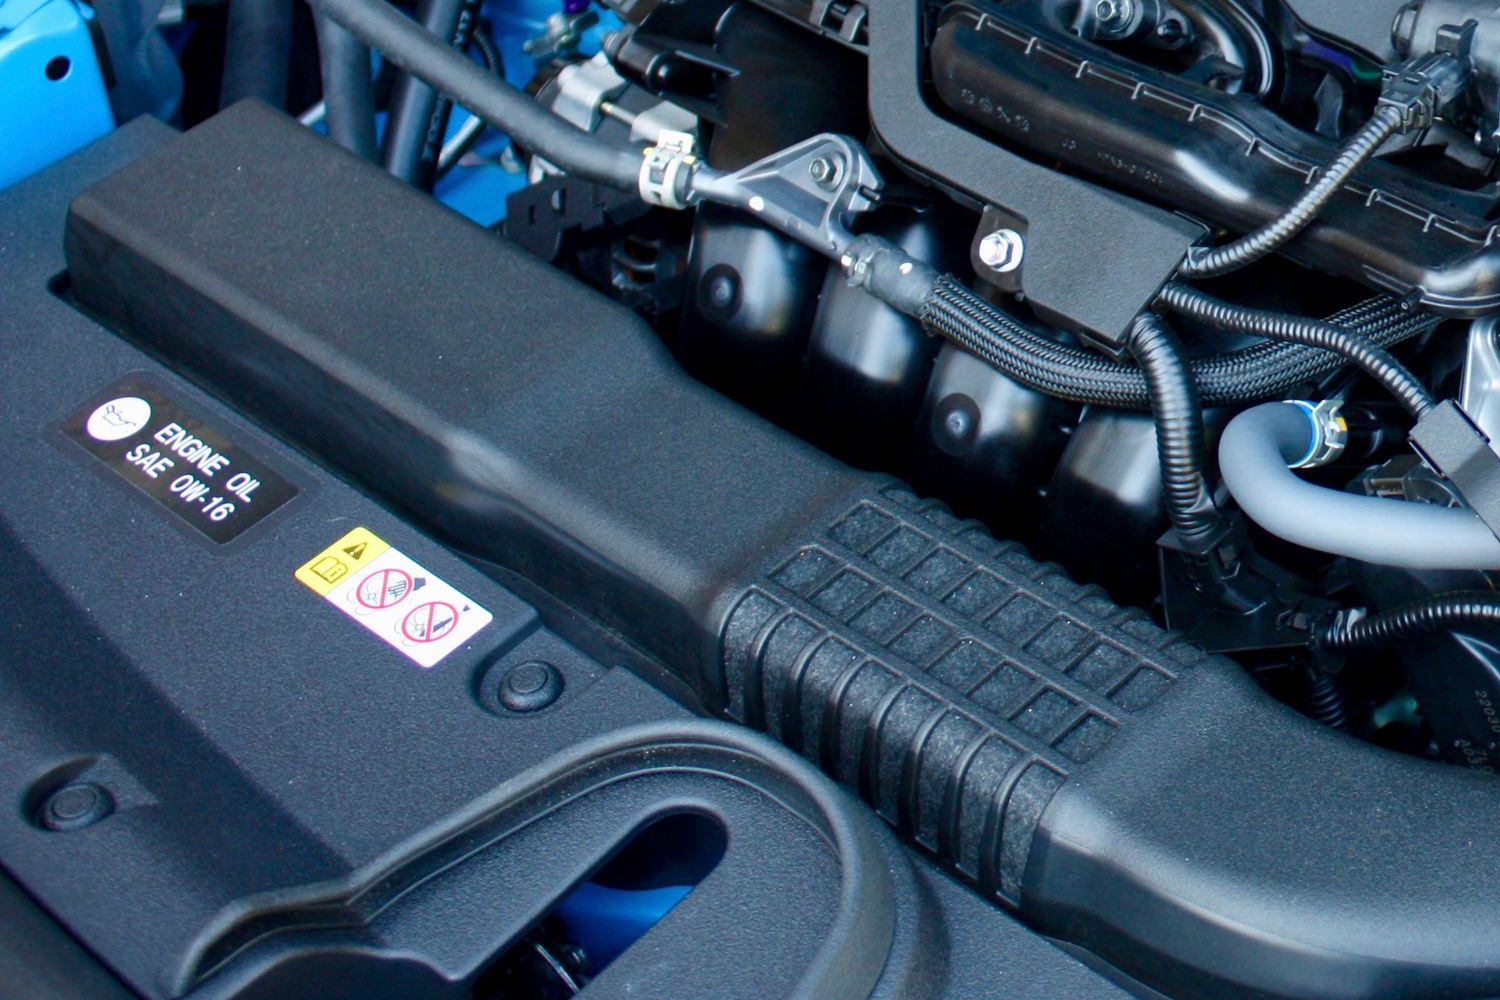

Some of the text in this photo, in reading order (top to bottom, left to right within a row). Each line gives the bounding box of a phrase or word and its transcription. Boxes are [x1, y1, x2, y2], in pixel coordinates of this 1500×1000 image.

[125, 443, 236, 521] SAE 0W-16
[153, 422, 261, 503] ENGINE OIL
